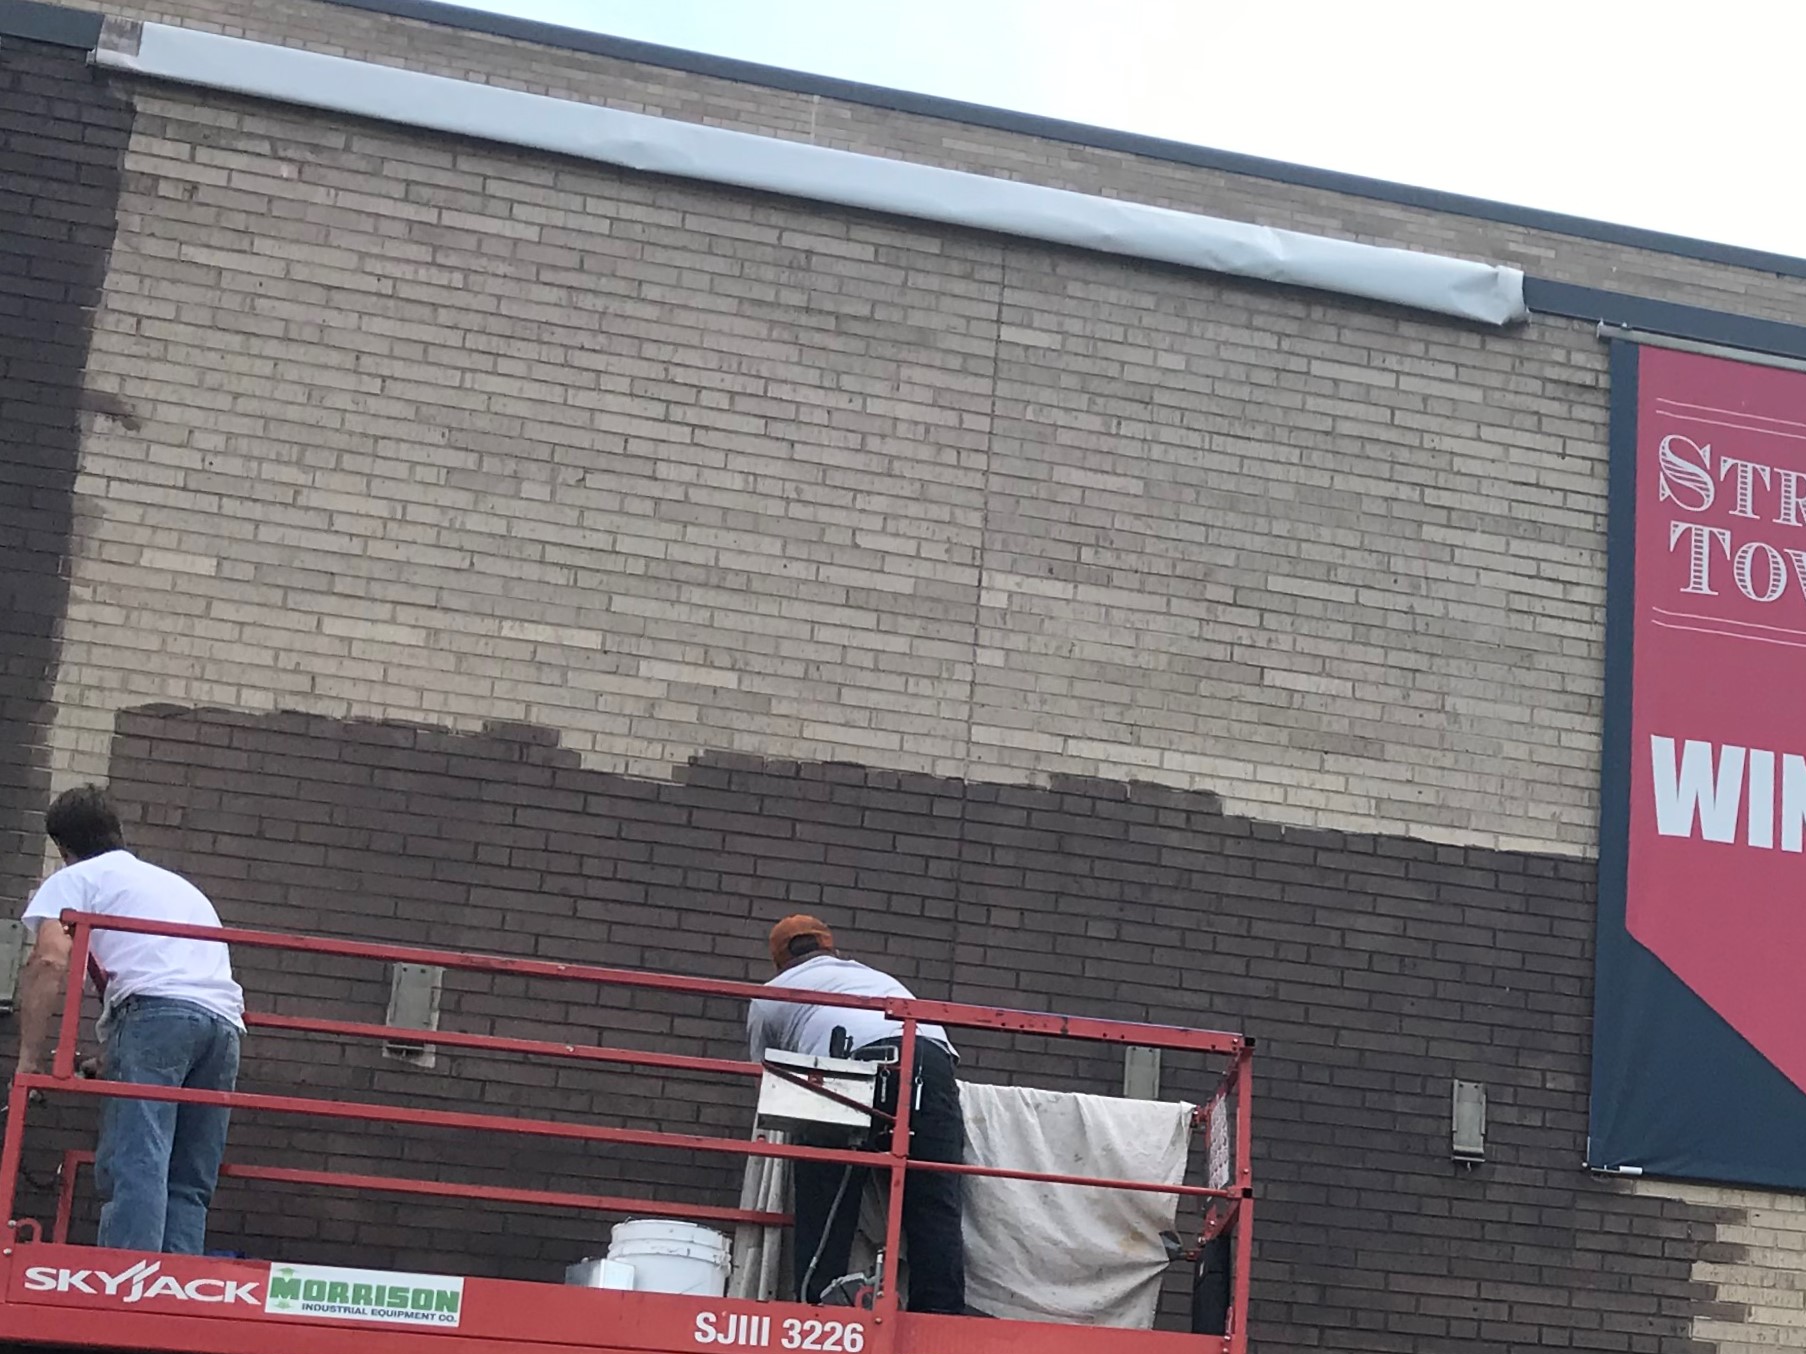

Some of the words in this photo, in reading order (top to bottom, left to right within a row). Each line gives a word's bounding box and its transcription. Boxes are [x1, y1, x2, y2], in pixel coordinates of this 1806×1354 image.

[24, 1259, 262, 1305] SKYJACK
[269, 1276, 460, 1313] MORRISON
[302, 1302, 368, 1316] INDUSTRIAL
[371, 1309, 436, 1321] EQUIPMENT
[694, 1311, 770, 1346] SJIII
[781, 1318, 864, 1353] 3226
